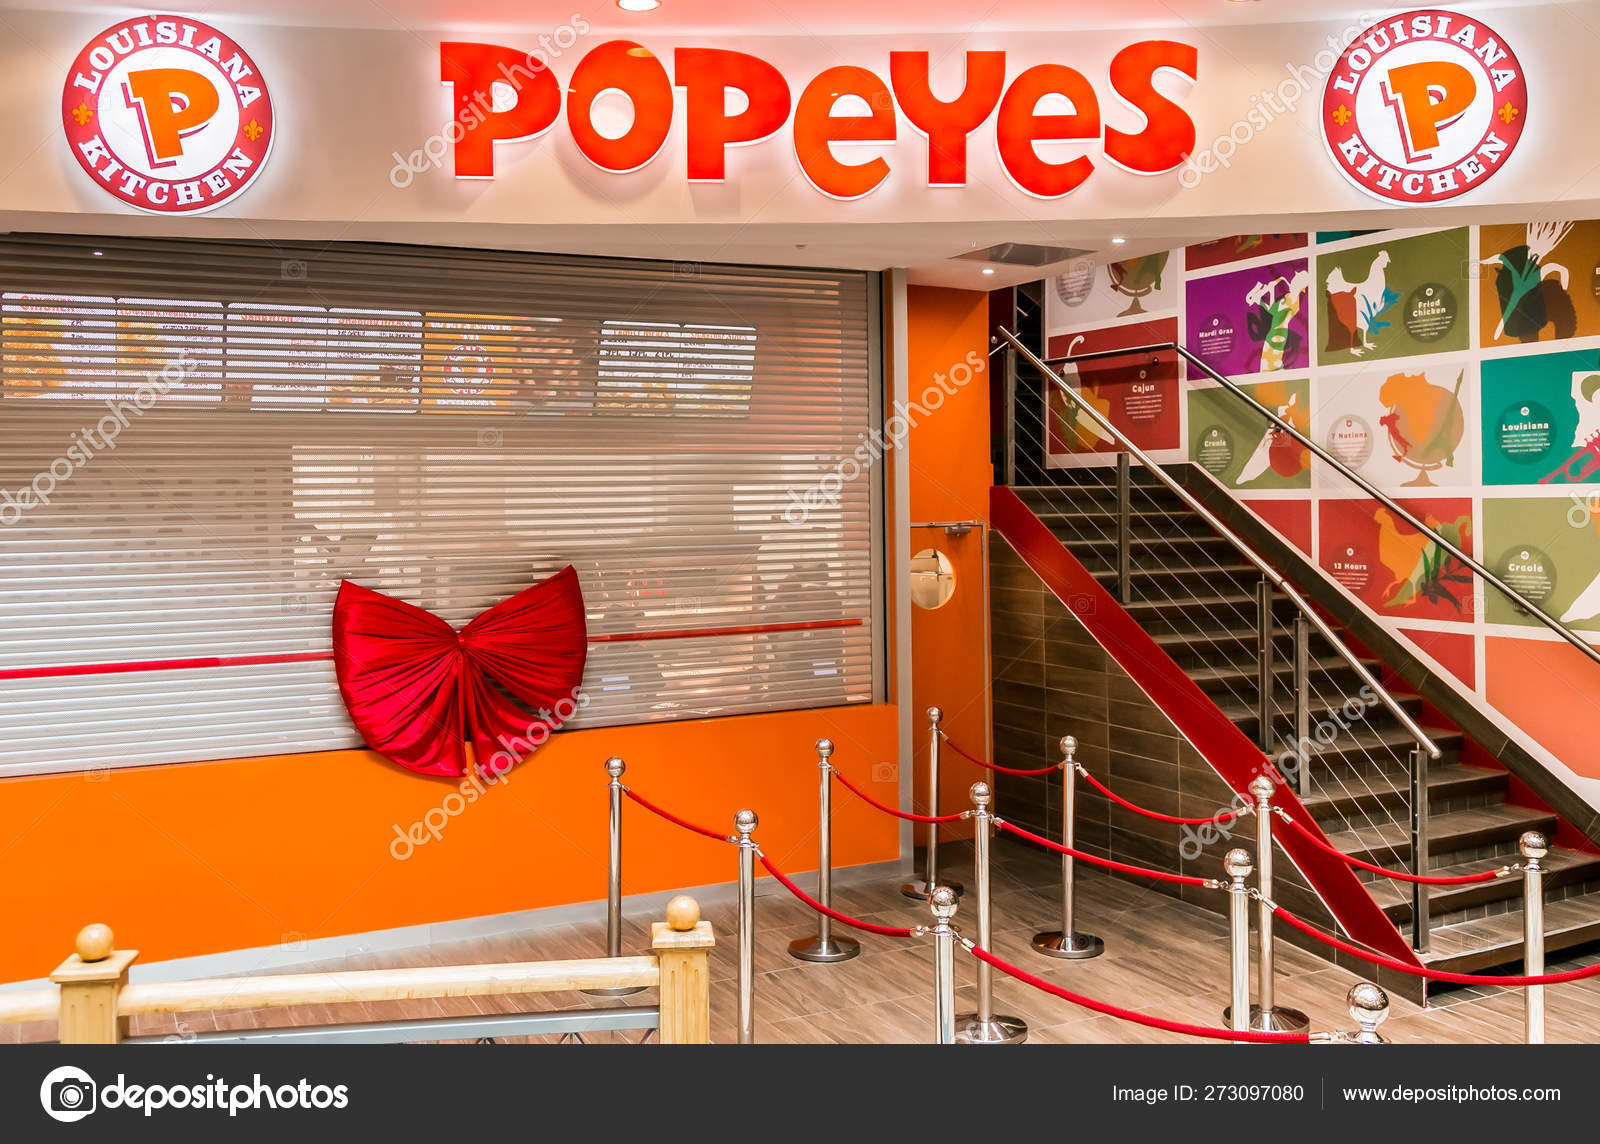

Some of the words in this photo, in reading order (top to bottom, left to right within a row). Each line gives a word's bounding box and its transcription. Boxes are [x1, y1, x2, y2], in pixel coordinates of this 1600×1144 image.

[73, 21, 262, 108] LOUISIANA
[1333, 15, 1517, 94] LOUISIANA
[121, 68, 220, 169] P
[1379, 61, 1477, 164] P
[78, 134, 253, 206] KITCHEN
[1337, 131, 1508, 195] KITCHEN
[1412, 307, 1447, 317] Chicken
[1417, 299, 1441, 309] Fried
[1132, 383, 1155, 394] Cajun
[1501, 422, 1550, 432] Louisiana
[1508, 563, 1544, 572] Creole
